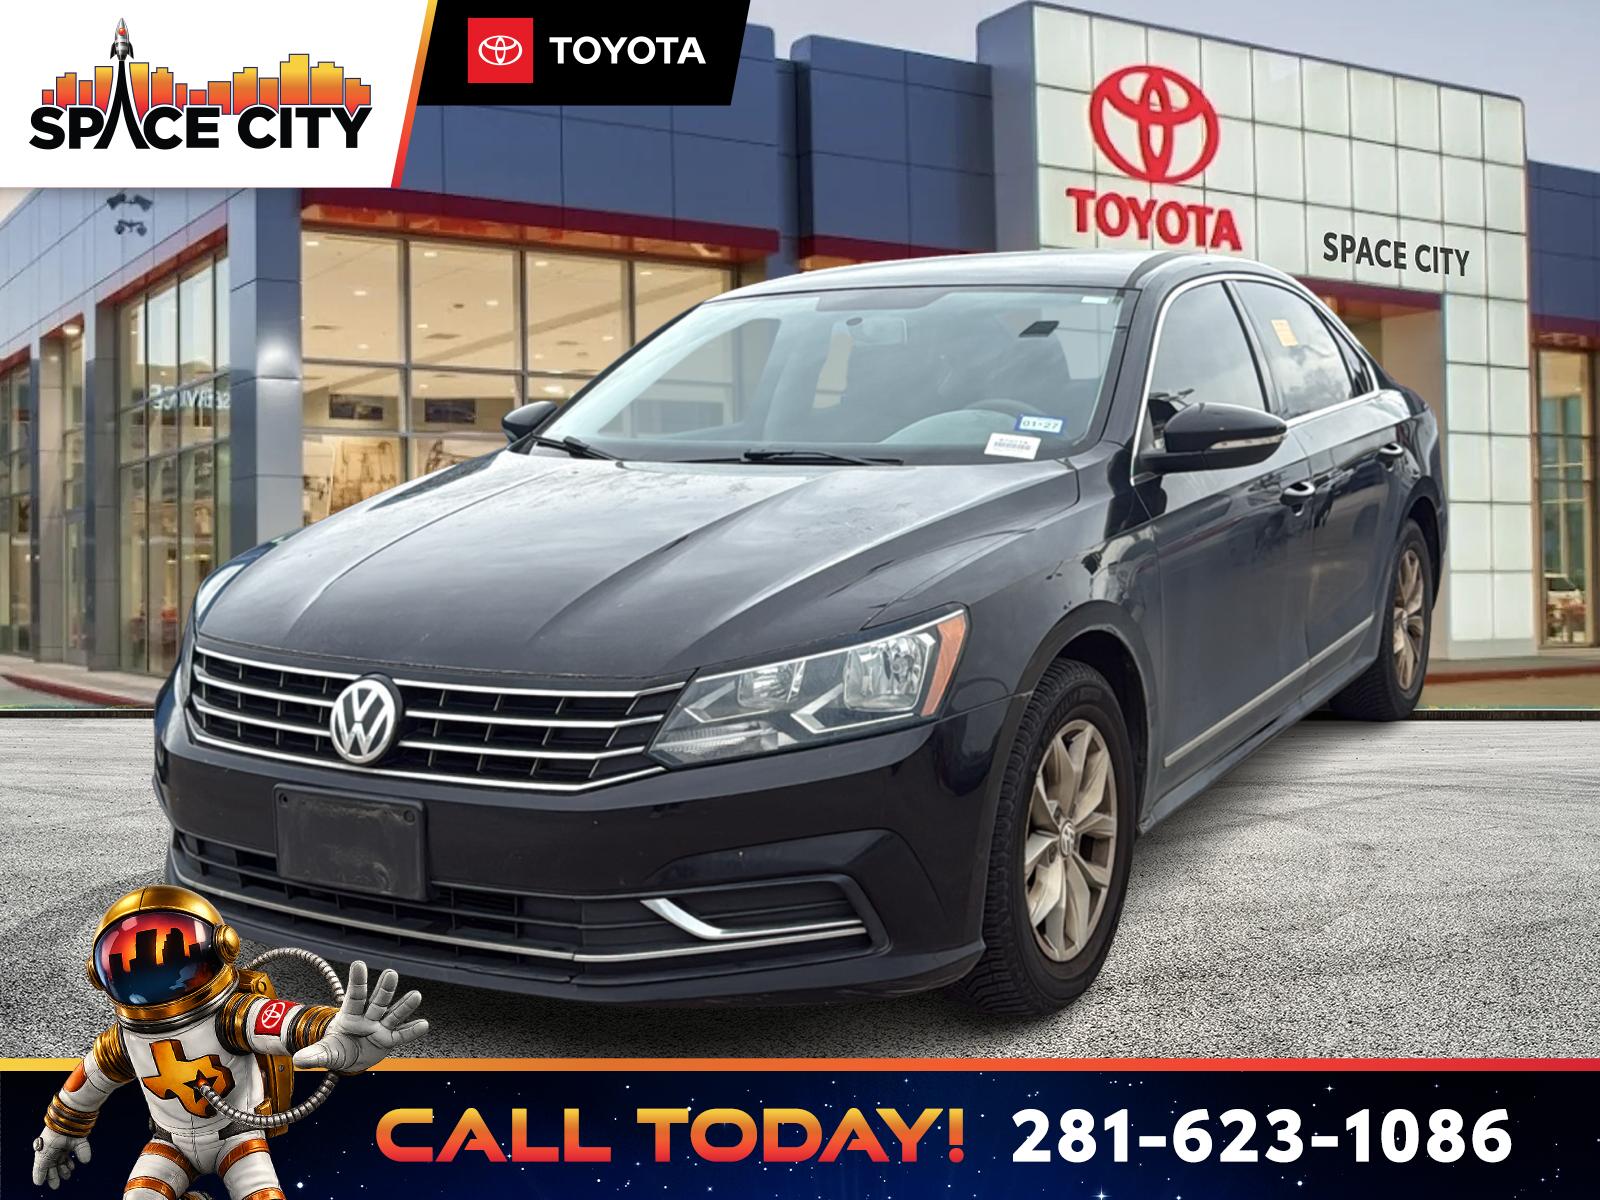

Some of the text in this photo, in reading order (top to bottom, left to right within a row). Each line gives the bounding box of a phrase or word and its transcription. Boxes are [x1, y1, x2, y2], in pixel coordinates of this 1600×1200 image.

[1065, 187, 1242, 251] TOYOTA
[1322, 231, 1471, 277] SPACE CITY
